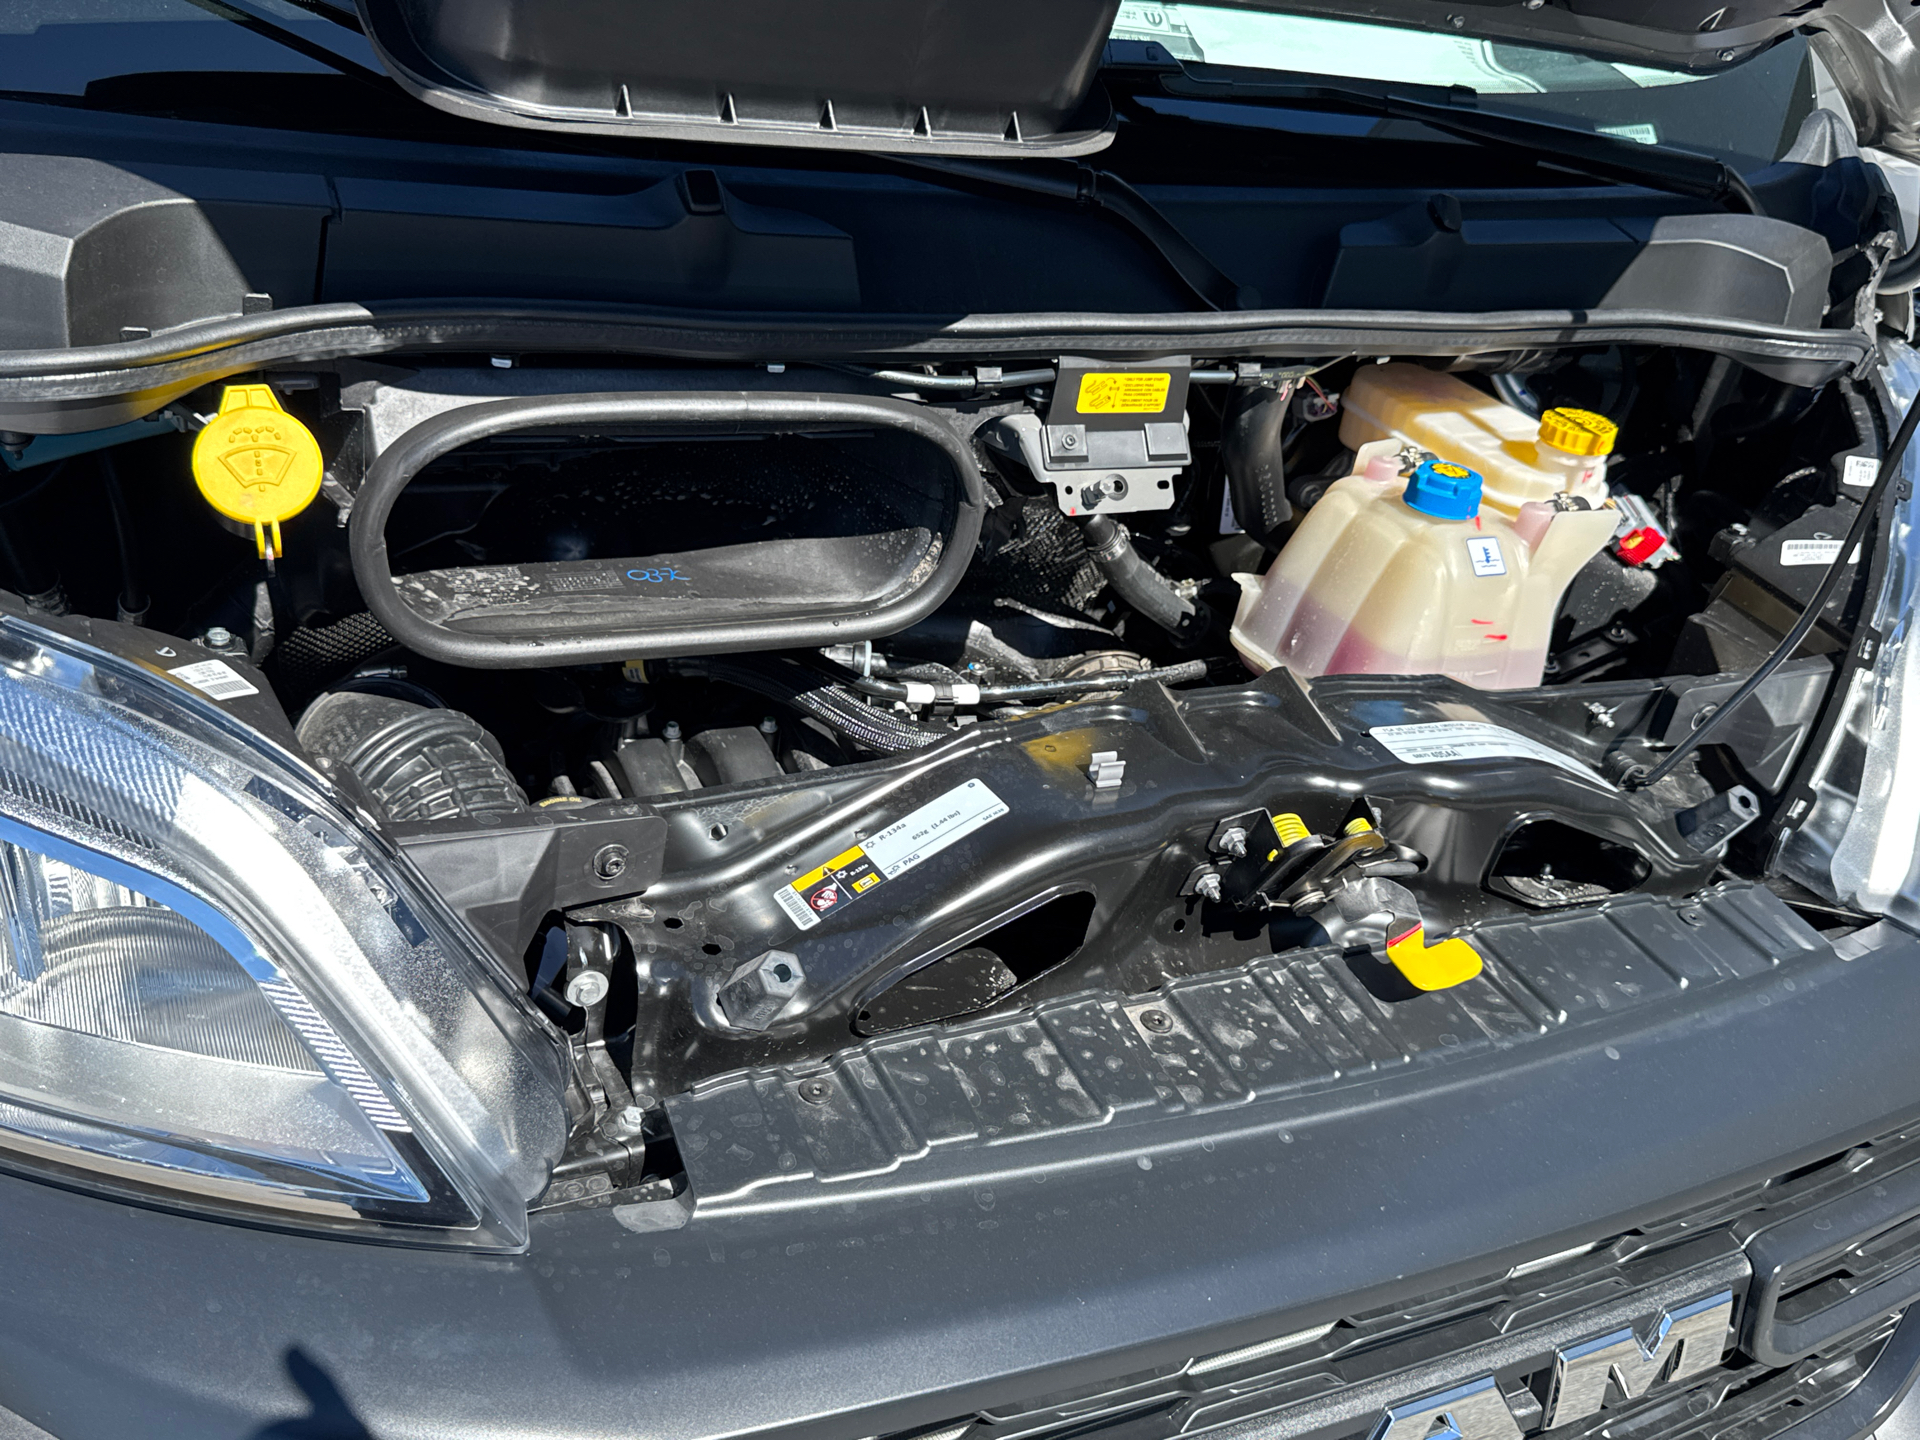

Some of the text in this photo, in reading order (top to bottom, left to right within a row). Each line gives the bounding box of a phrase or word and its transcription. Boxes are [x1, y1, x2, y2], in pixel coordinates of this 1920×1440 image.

[878, 823, 907, 841] R-134a
[911, 810, 961, 841] 652g (1.44 lbs)
[902, 853, 921, 866] PAG
